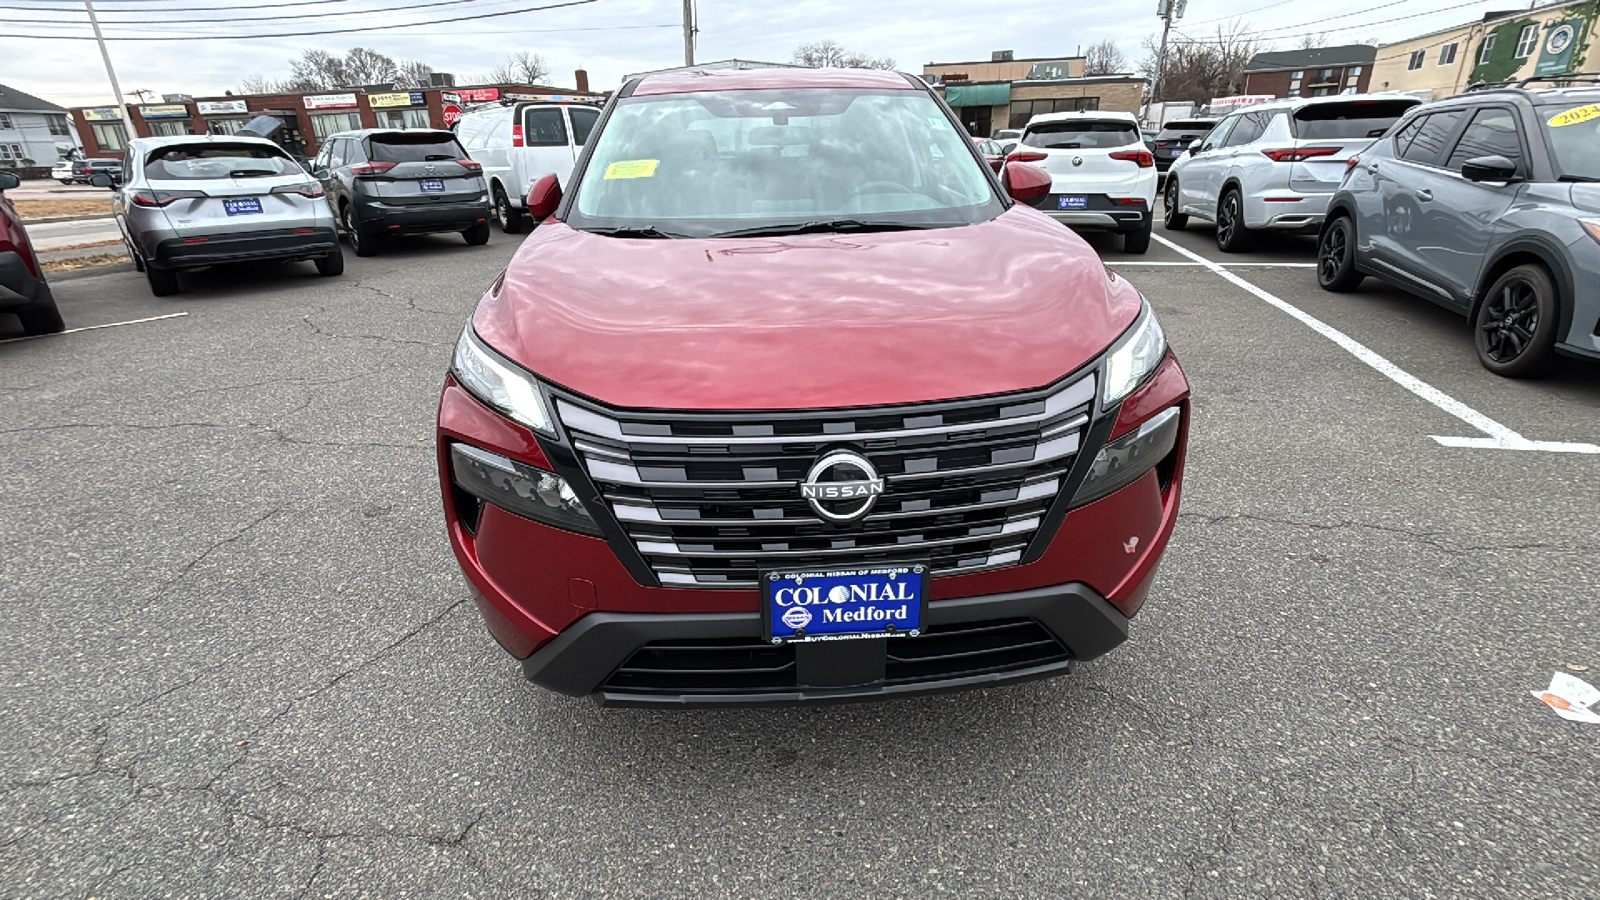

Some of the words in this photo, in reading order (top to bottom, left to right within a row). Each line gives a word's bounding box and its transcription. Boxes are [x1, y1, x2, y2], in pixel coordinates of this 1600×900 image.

[1560, 105, 1600, 124] 2024
[803, 483, 883, 497] NISSAN
[775, 582, 914, 607] COLONIAL
[822, 605, 907, 624] Medford
